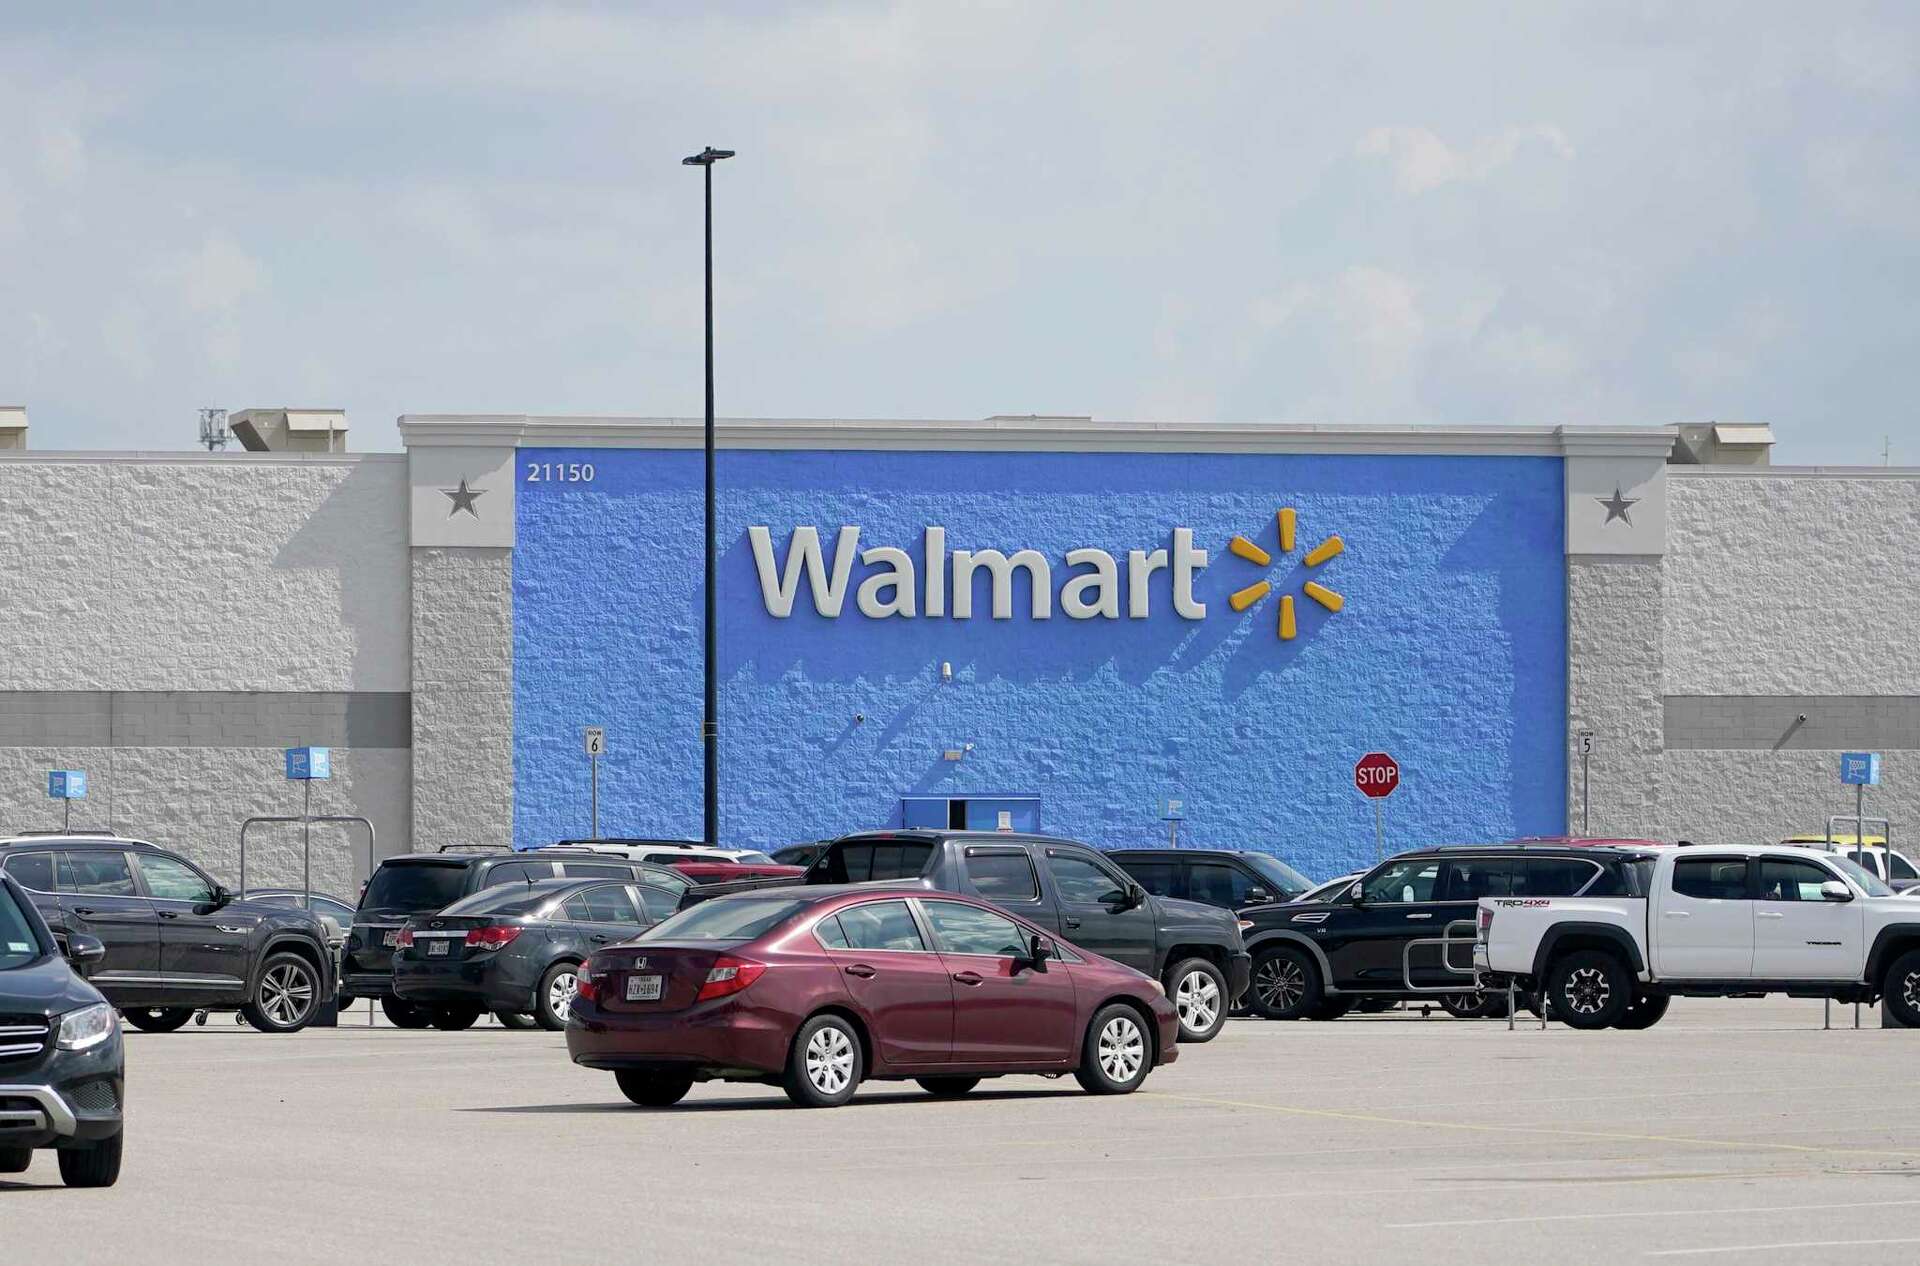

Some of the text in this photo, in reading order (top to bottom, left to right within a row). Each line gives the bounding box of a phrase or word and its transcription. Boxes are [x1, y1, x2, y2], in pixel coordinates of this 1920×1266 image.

[527, 463, 595, 482] 21150
[748, 526, 1208, 619] Walmart
[592, 737, 598, 752] 6
[1584, 738, 1590, 752] 5
[1358, 766, 1396, 784] STOP
